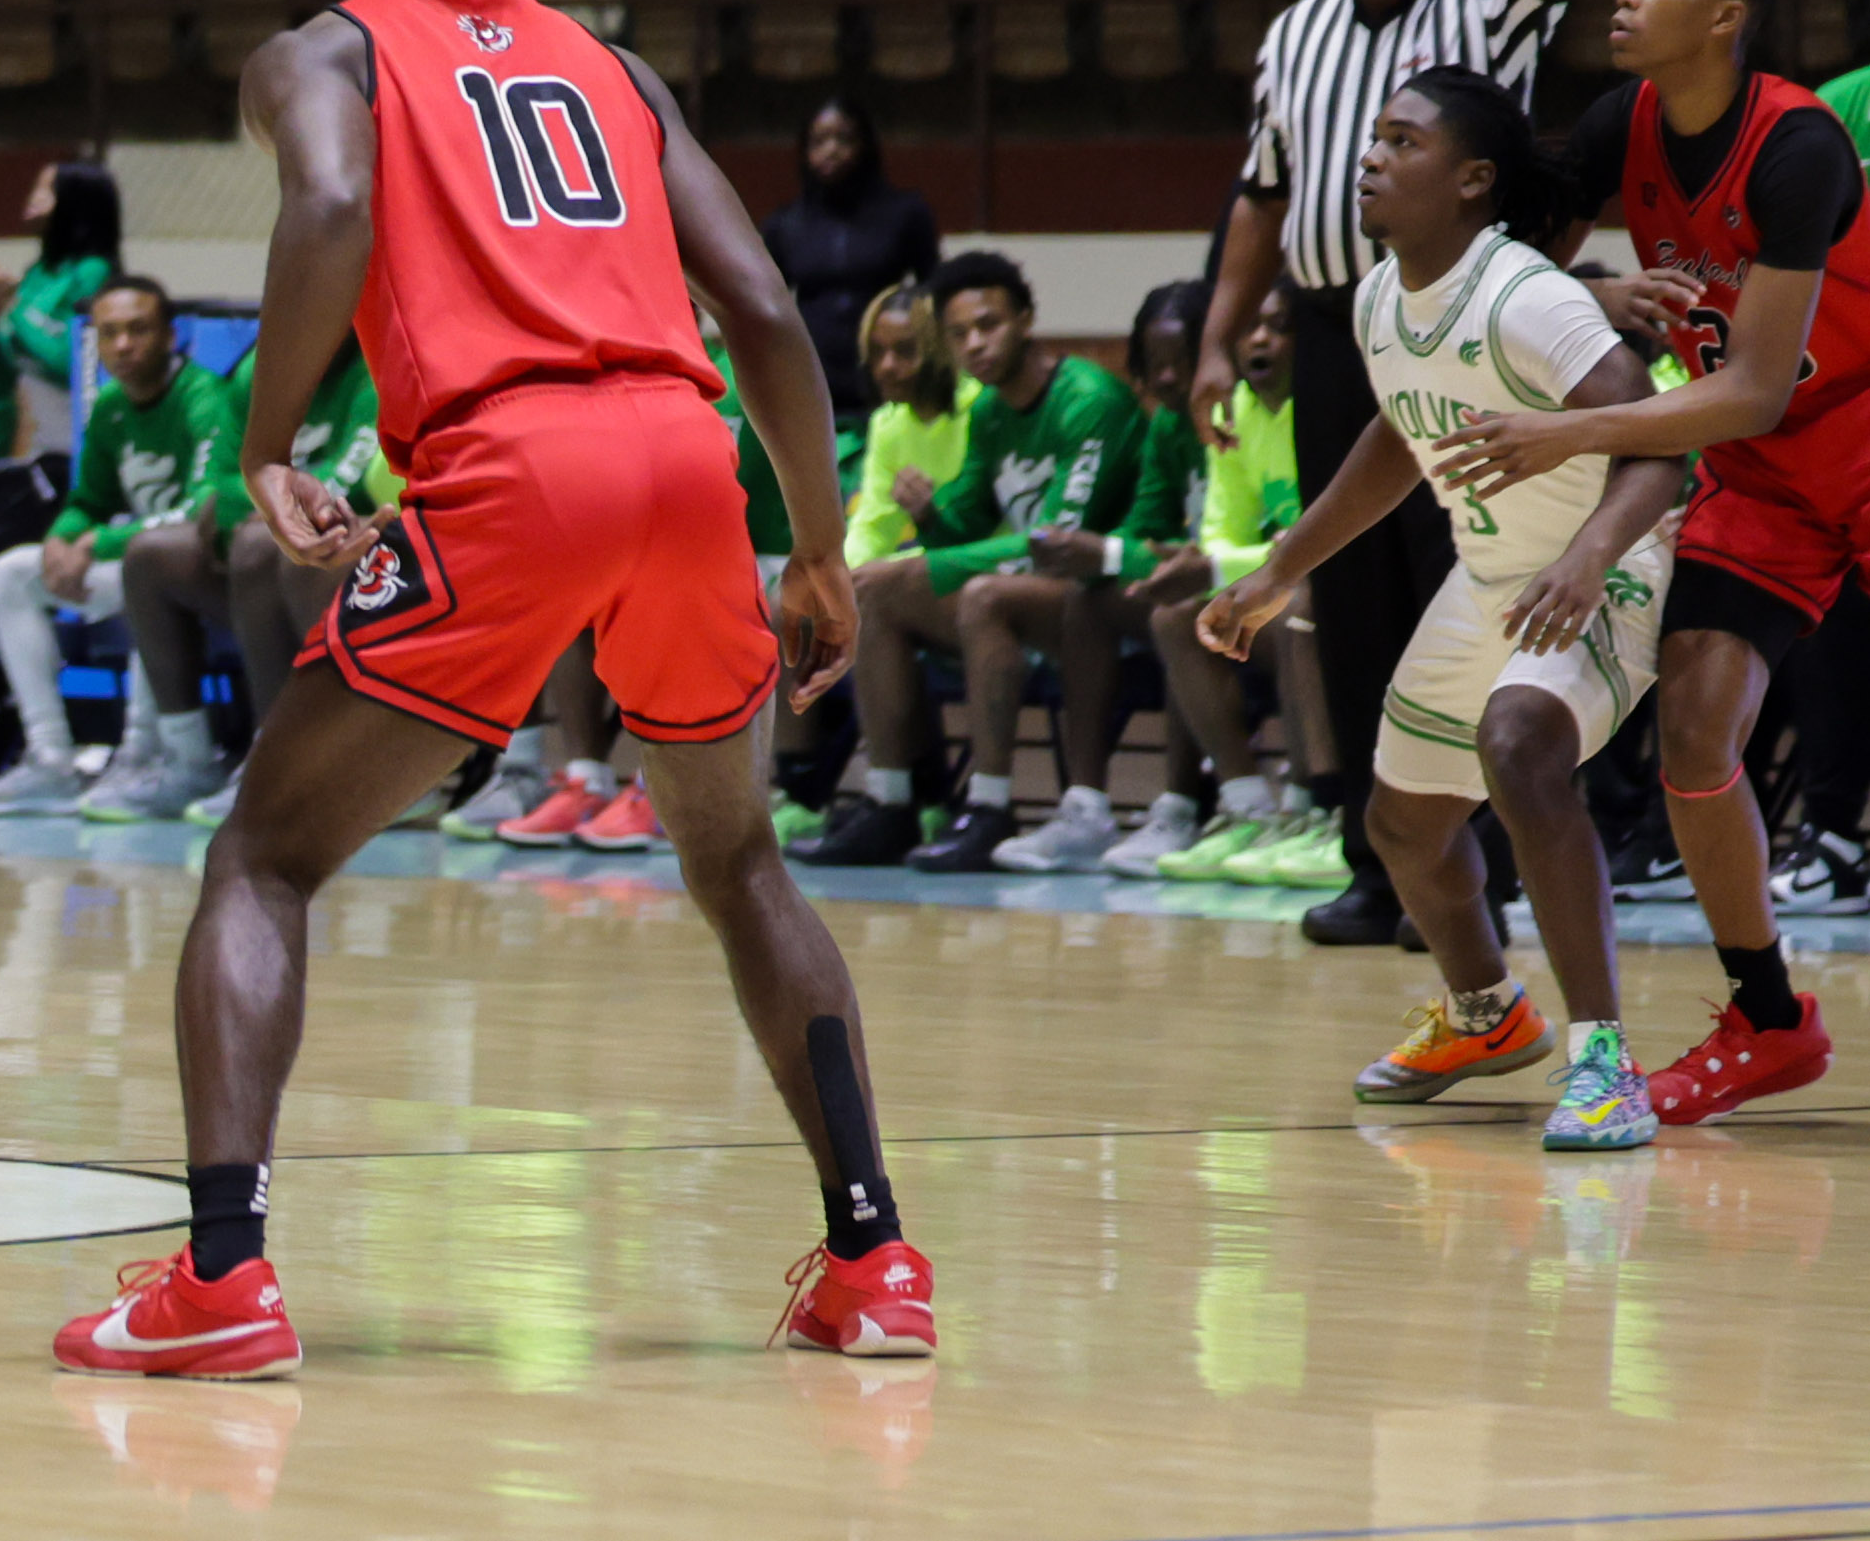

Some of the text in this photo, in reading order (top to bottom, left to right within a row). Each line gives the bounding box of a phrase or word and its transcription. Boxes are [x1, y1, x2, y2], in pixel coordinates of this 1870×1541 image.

[455, 65, 627, 228] 10
[1656, 239, 1750, 290] Eufaul
[1380, 389, 1500, 448] OLVE
